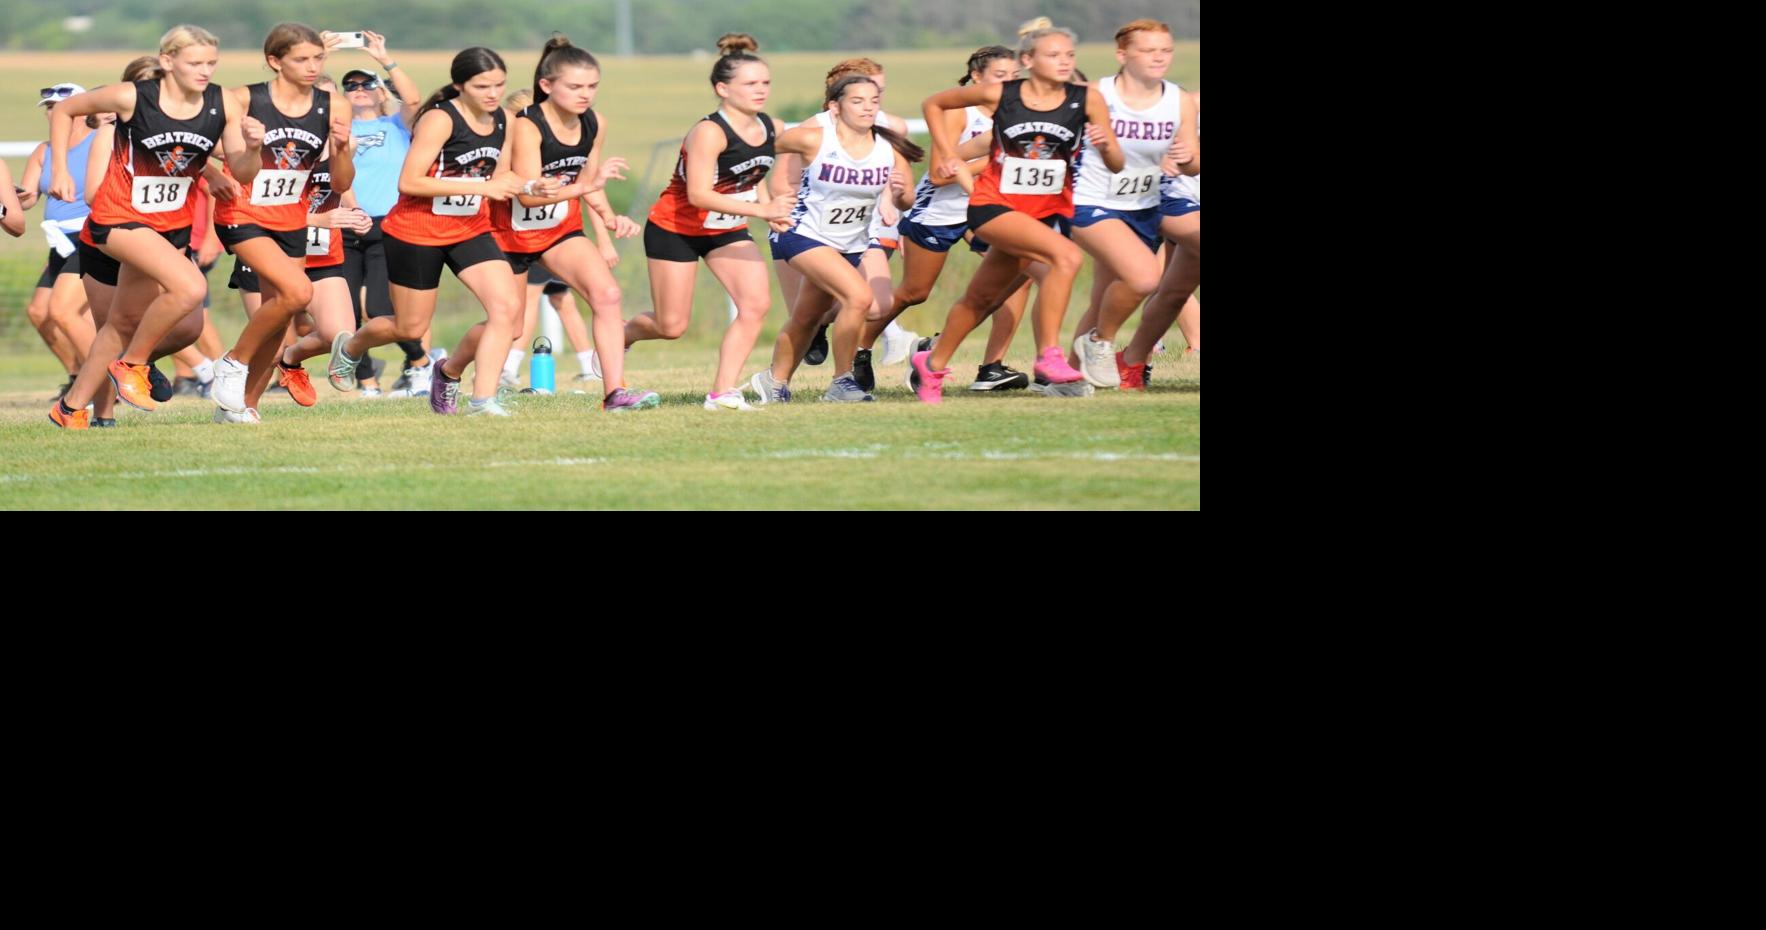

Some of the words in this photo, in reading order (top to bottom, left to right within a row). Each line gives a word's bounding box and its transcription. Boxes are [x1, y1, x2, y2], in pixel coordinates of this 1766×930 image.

[1110, 119, 1174, 140] ORRIS
[141, 131, 214, 152] BEATRICE
[818, 163, 889, 186] NORRIS
[1012, 166, 1055, 187] 135
[1116, 174, 1153, 196] 219
[141, 183, 180, 205] 138
[261, 177, 297, 198] 131
[828, 205, 867, 225] 224
